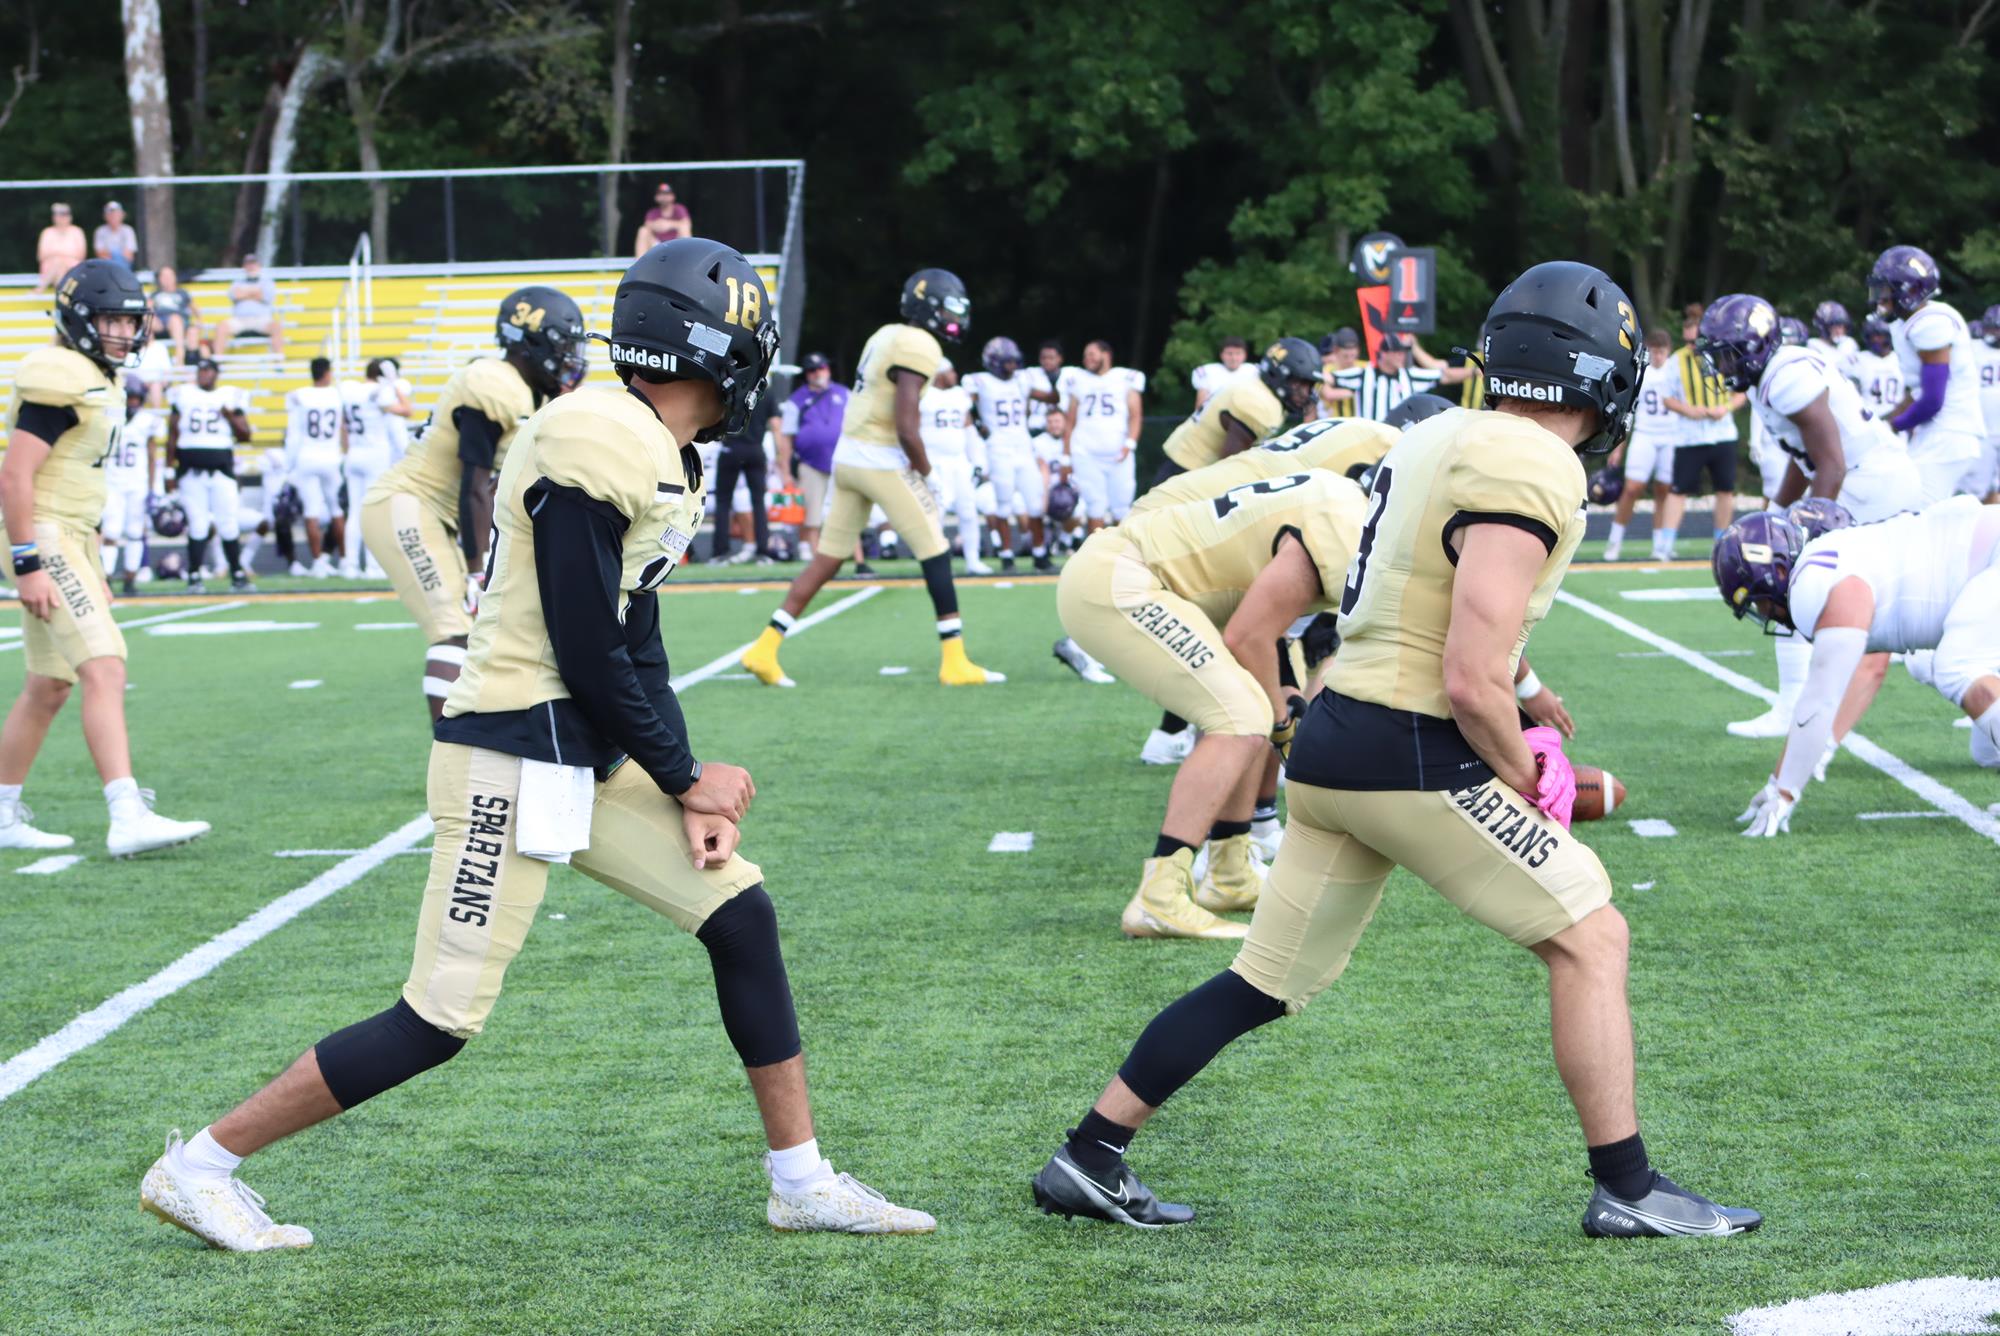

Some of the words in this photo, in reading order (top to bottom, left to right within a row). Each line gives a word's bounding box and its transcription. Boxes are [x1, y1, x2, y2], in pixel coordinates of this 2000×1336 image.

[1398, 256, 1420, 303] 1
[510, 302, 546, 332] 34
[724, 276, 762, 332] 18
[611, 343, 678, 373] Riddell
[1489, 376, 1564, 403] Riddell
[1870, 377, 1899, 405] 40
[1980, 365, 2000, 388] 9
[1085, 393, 1116, 417] 75
[1644, 389, 1669, 416] 9
[307, 408, 337, 439] 83
[398, 527, 442, 592] SPARTANS
[41, 554, 95, 619] SPARTANS
[1131, 602, 1215, 670] SPARTANS
[449, 794, 511, 928] SPARTANS
